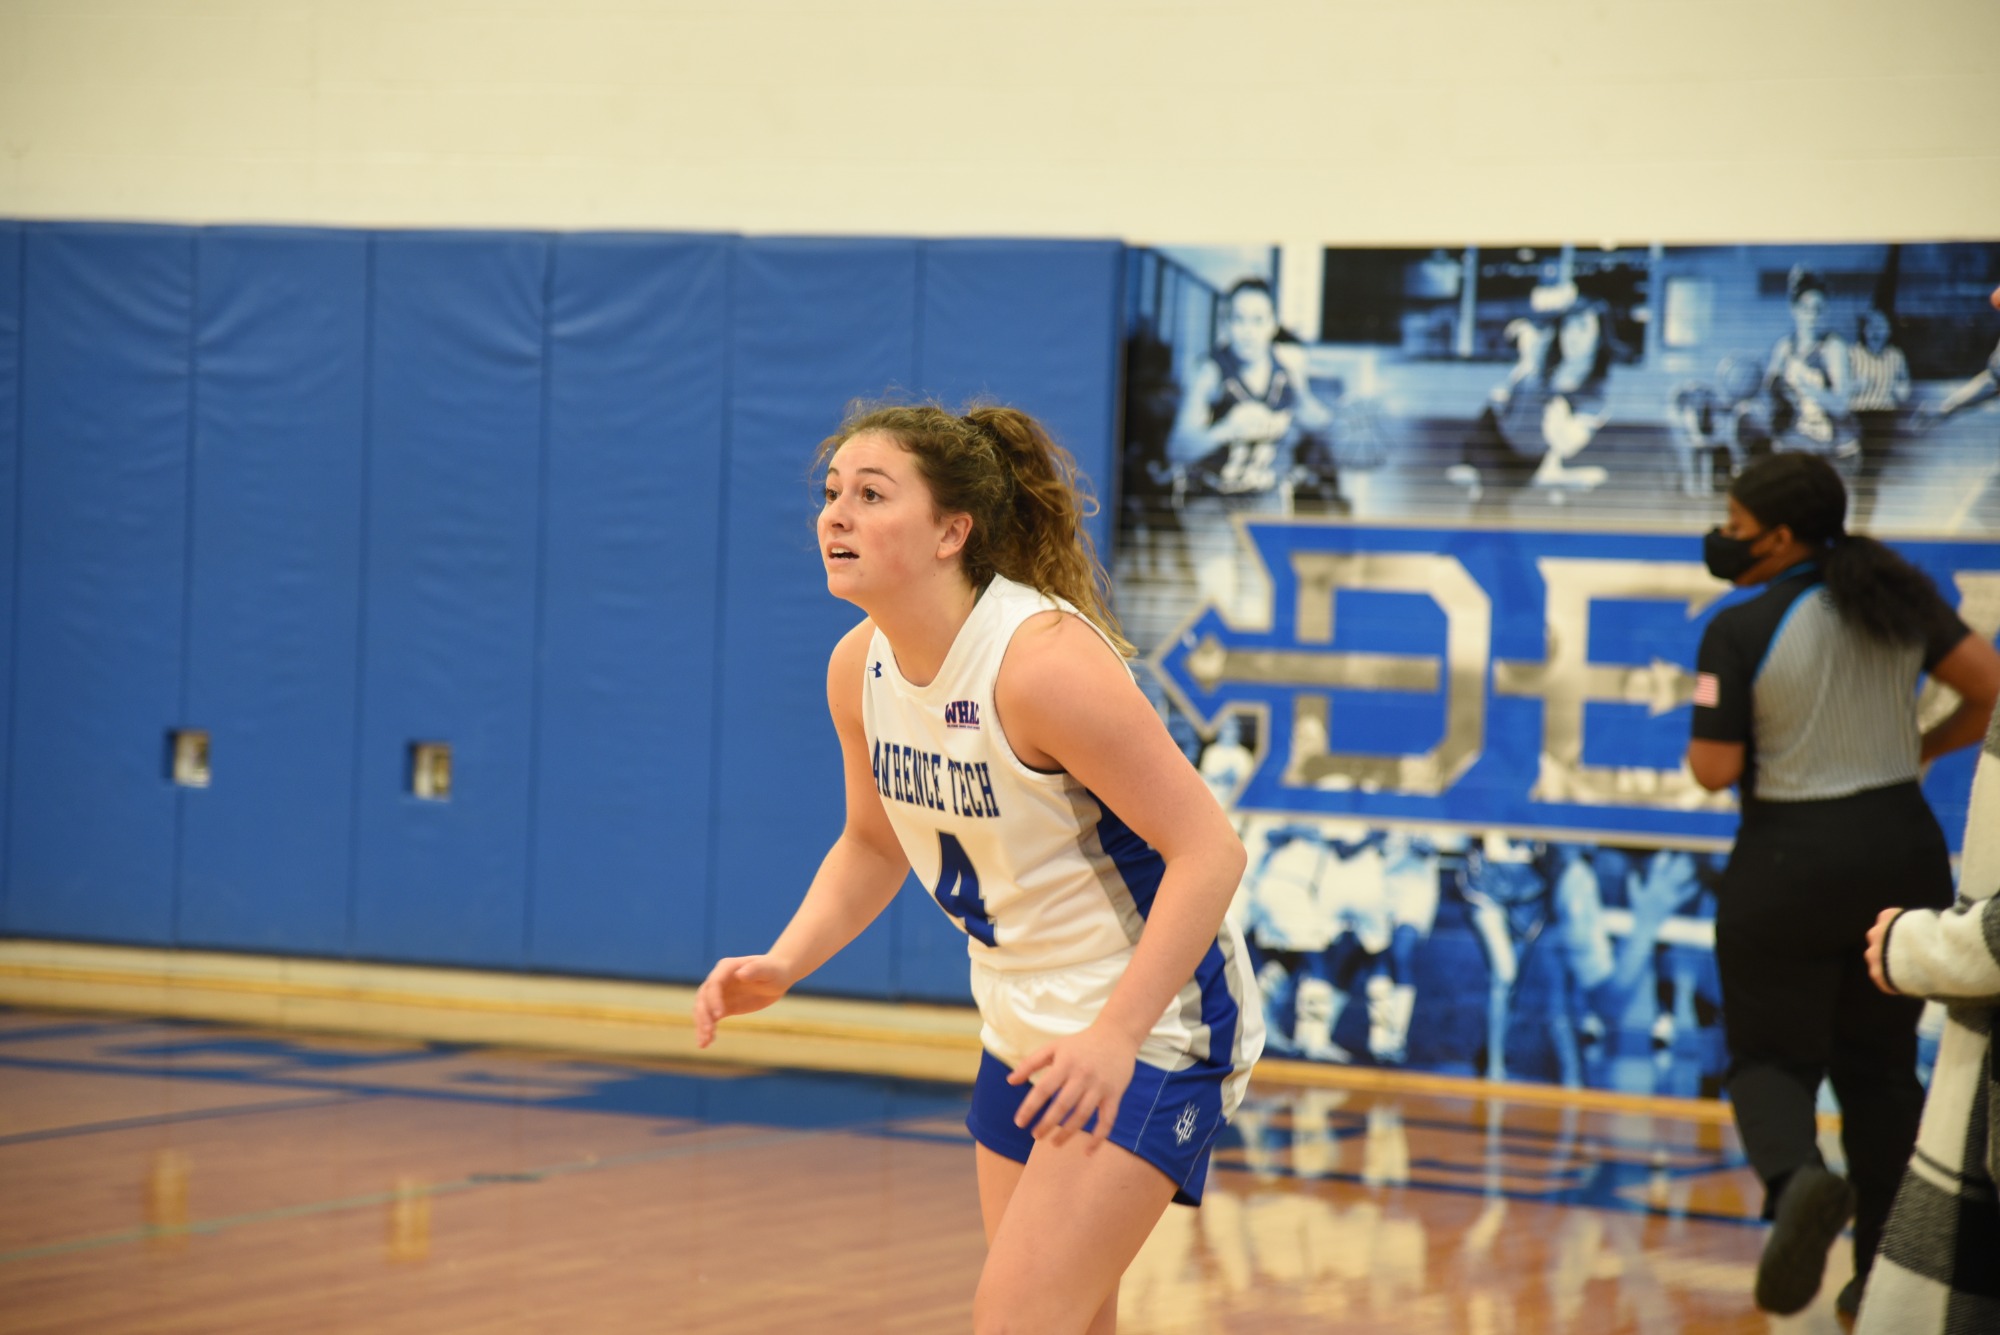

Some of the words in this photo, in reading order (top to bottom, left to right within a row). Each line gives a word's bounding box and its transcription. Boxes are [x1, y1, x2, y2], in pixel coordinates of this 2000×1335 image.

[945, 700, 980, 725] WHAC
[873, 736, 945, 812] AWRENCE
[947, 757, 1000, 818] TECH
[934, 828, 1000, 948] 4
